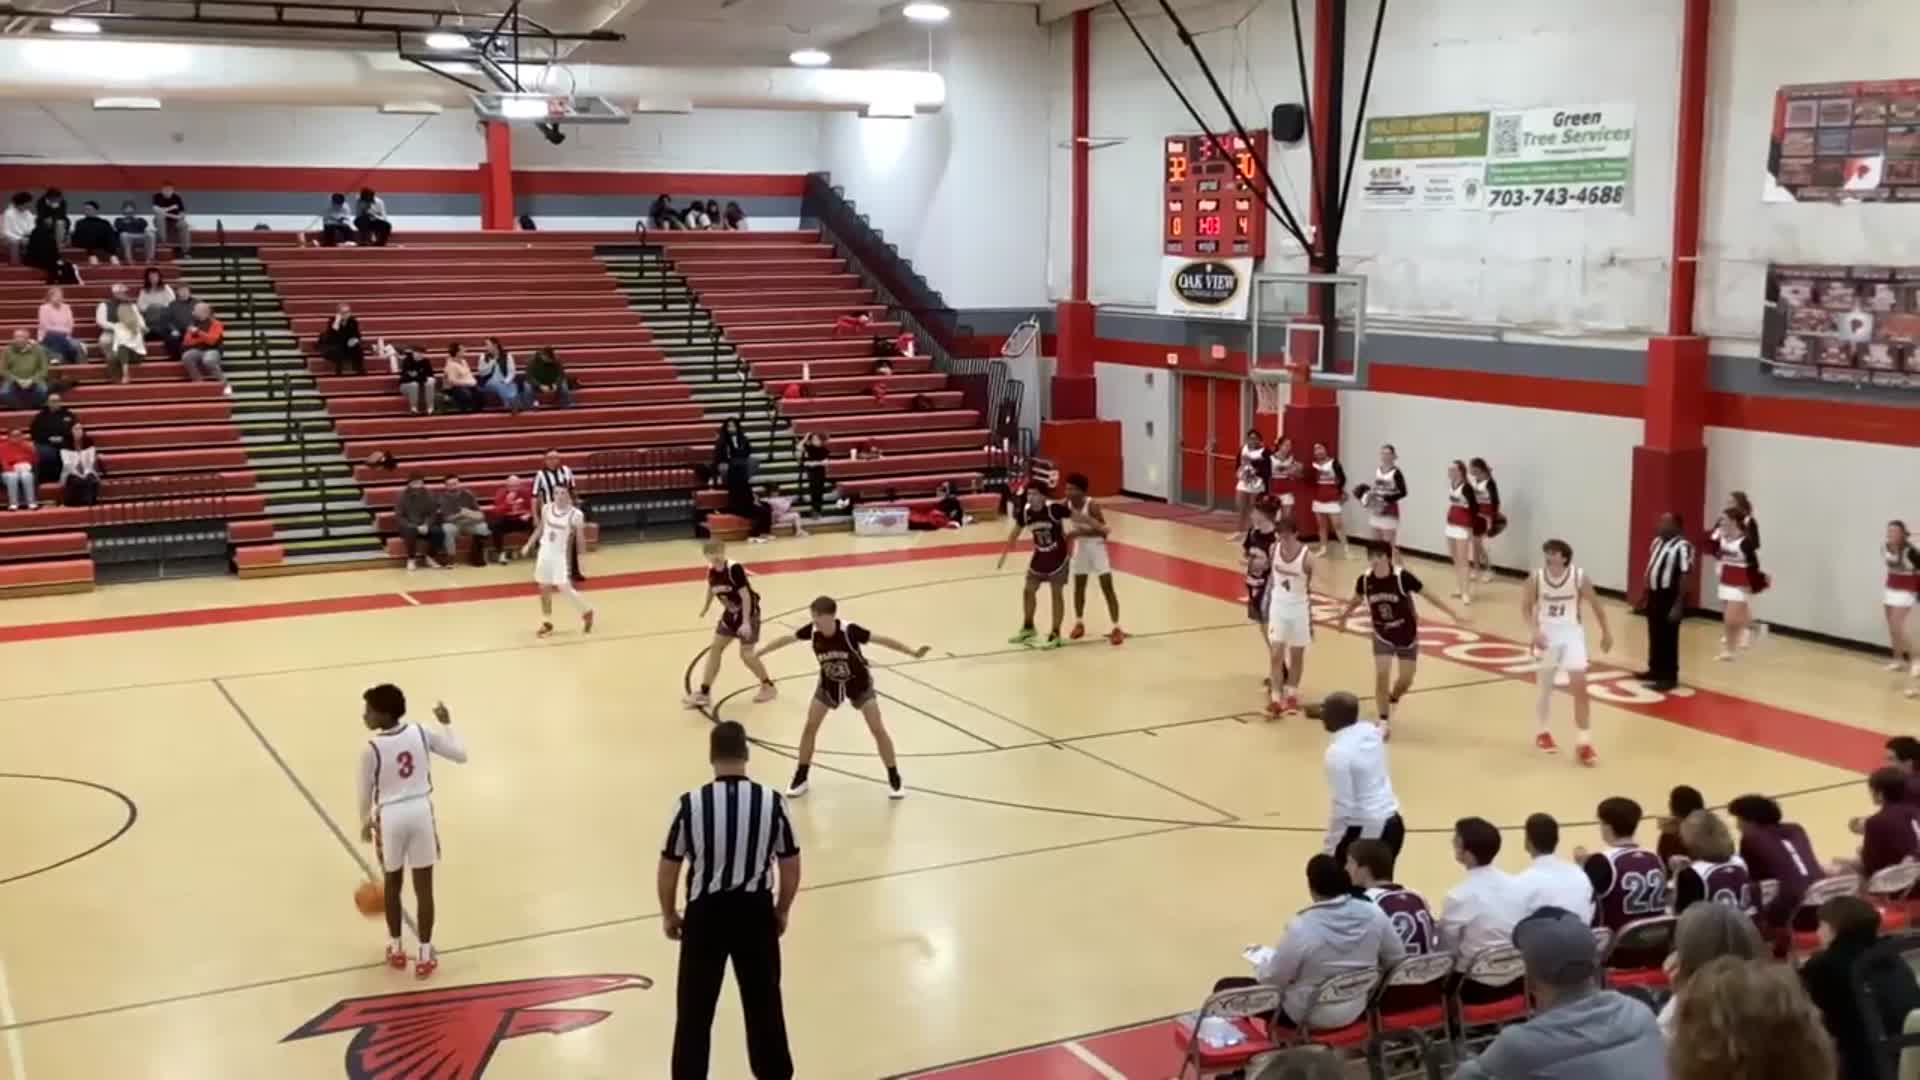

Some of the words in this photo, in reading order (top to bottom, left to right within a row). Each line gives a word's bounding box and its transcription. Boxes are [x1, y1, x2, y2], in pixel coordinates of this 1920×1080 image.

[1553, 111, 1602, 127] Green
[1524, 131, 1557, 147] Tree
[1561, 125, 1632, 144] Services
[1178, 273, 1202, 289] OAK
[1205, 274, 1234, 289] VIEW
[397, 751, 415, 779] 3
[1621, 869, 1667, 914] 22
[1391, 909, 1431, 955] 21
